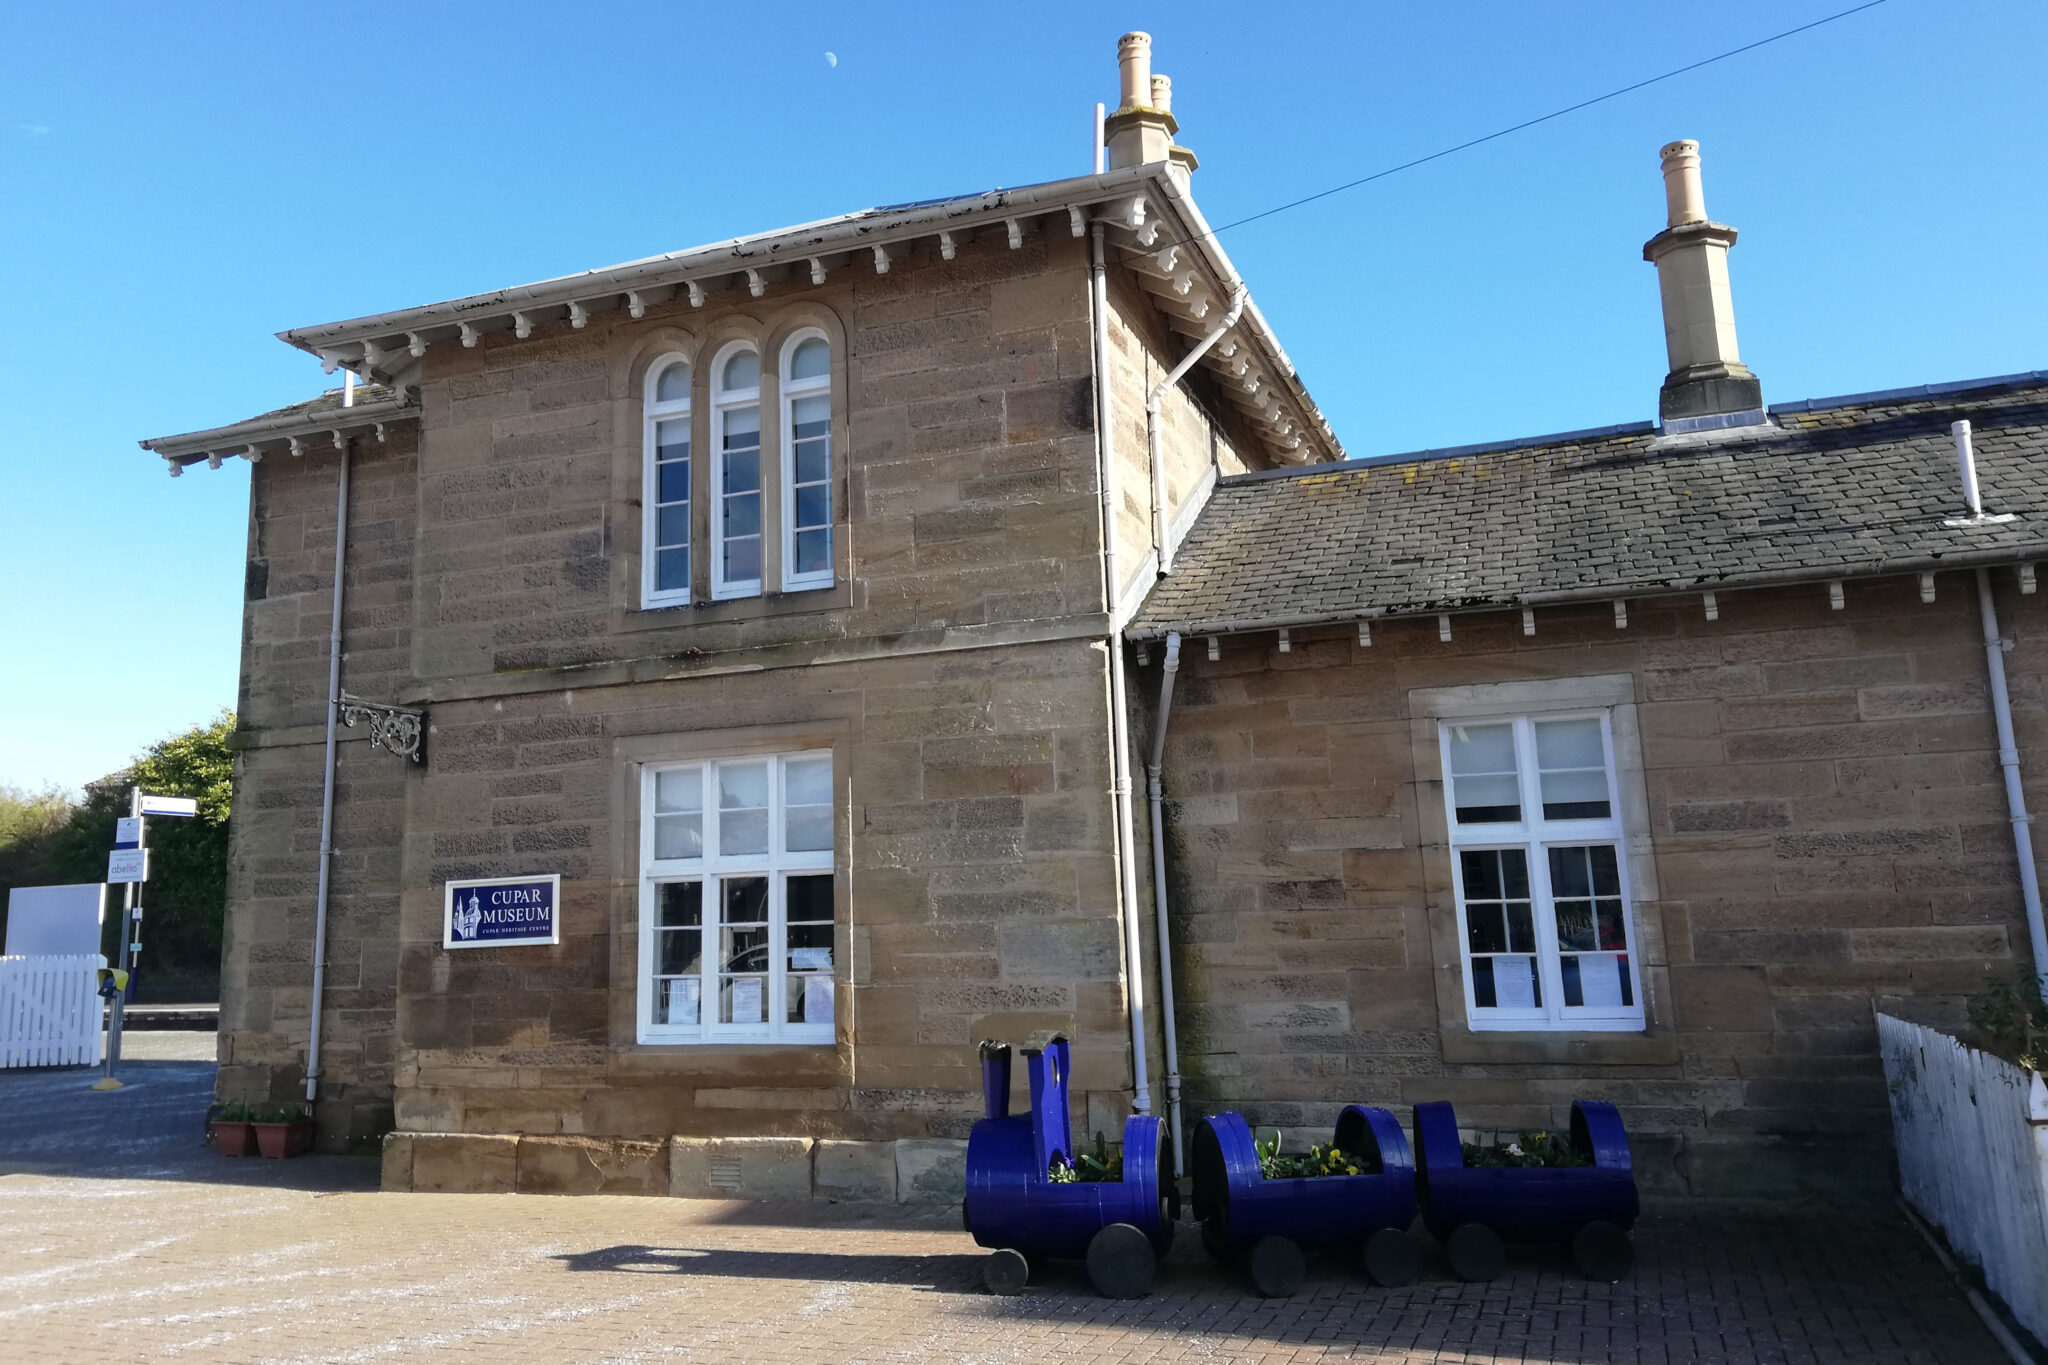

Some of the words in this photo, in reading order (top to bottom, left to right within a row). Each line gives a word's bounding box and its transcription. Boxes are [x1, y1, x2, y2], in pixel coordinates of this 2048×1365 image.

[111, 863, 137, 874] abellio
[492, 889, 542, 904] CUPAR
[484, 906, 550, 924] MUSEUM
